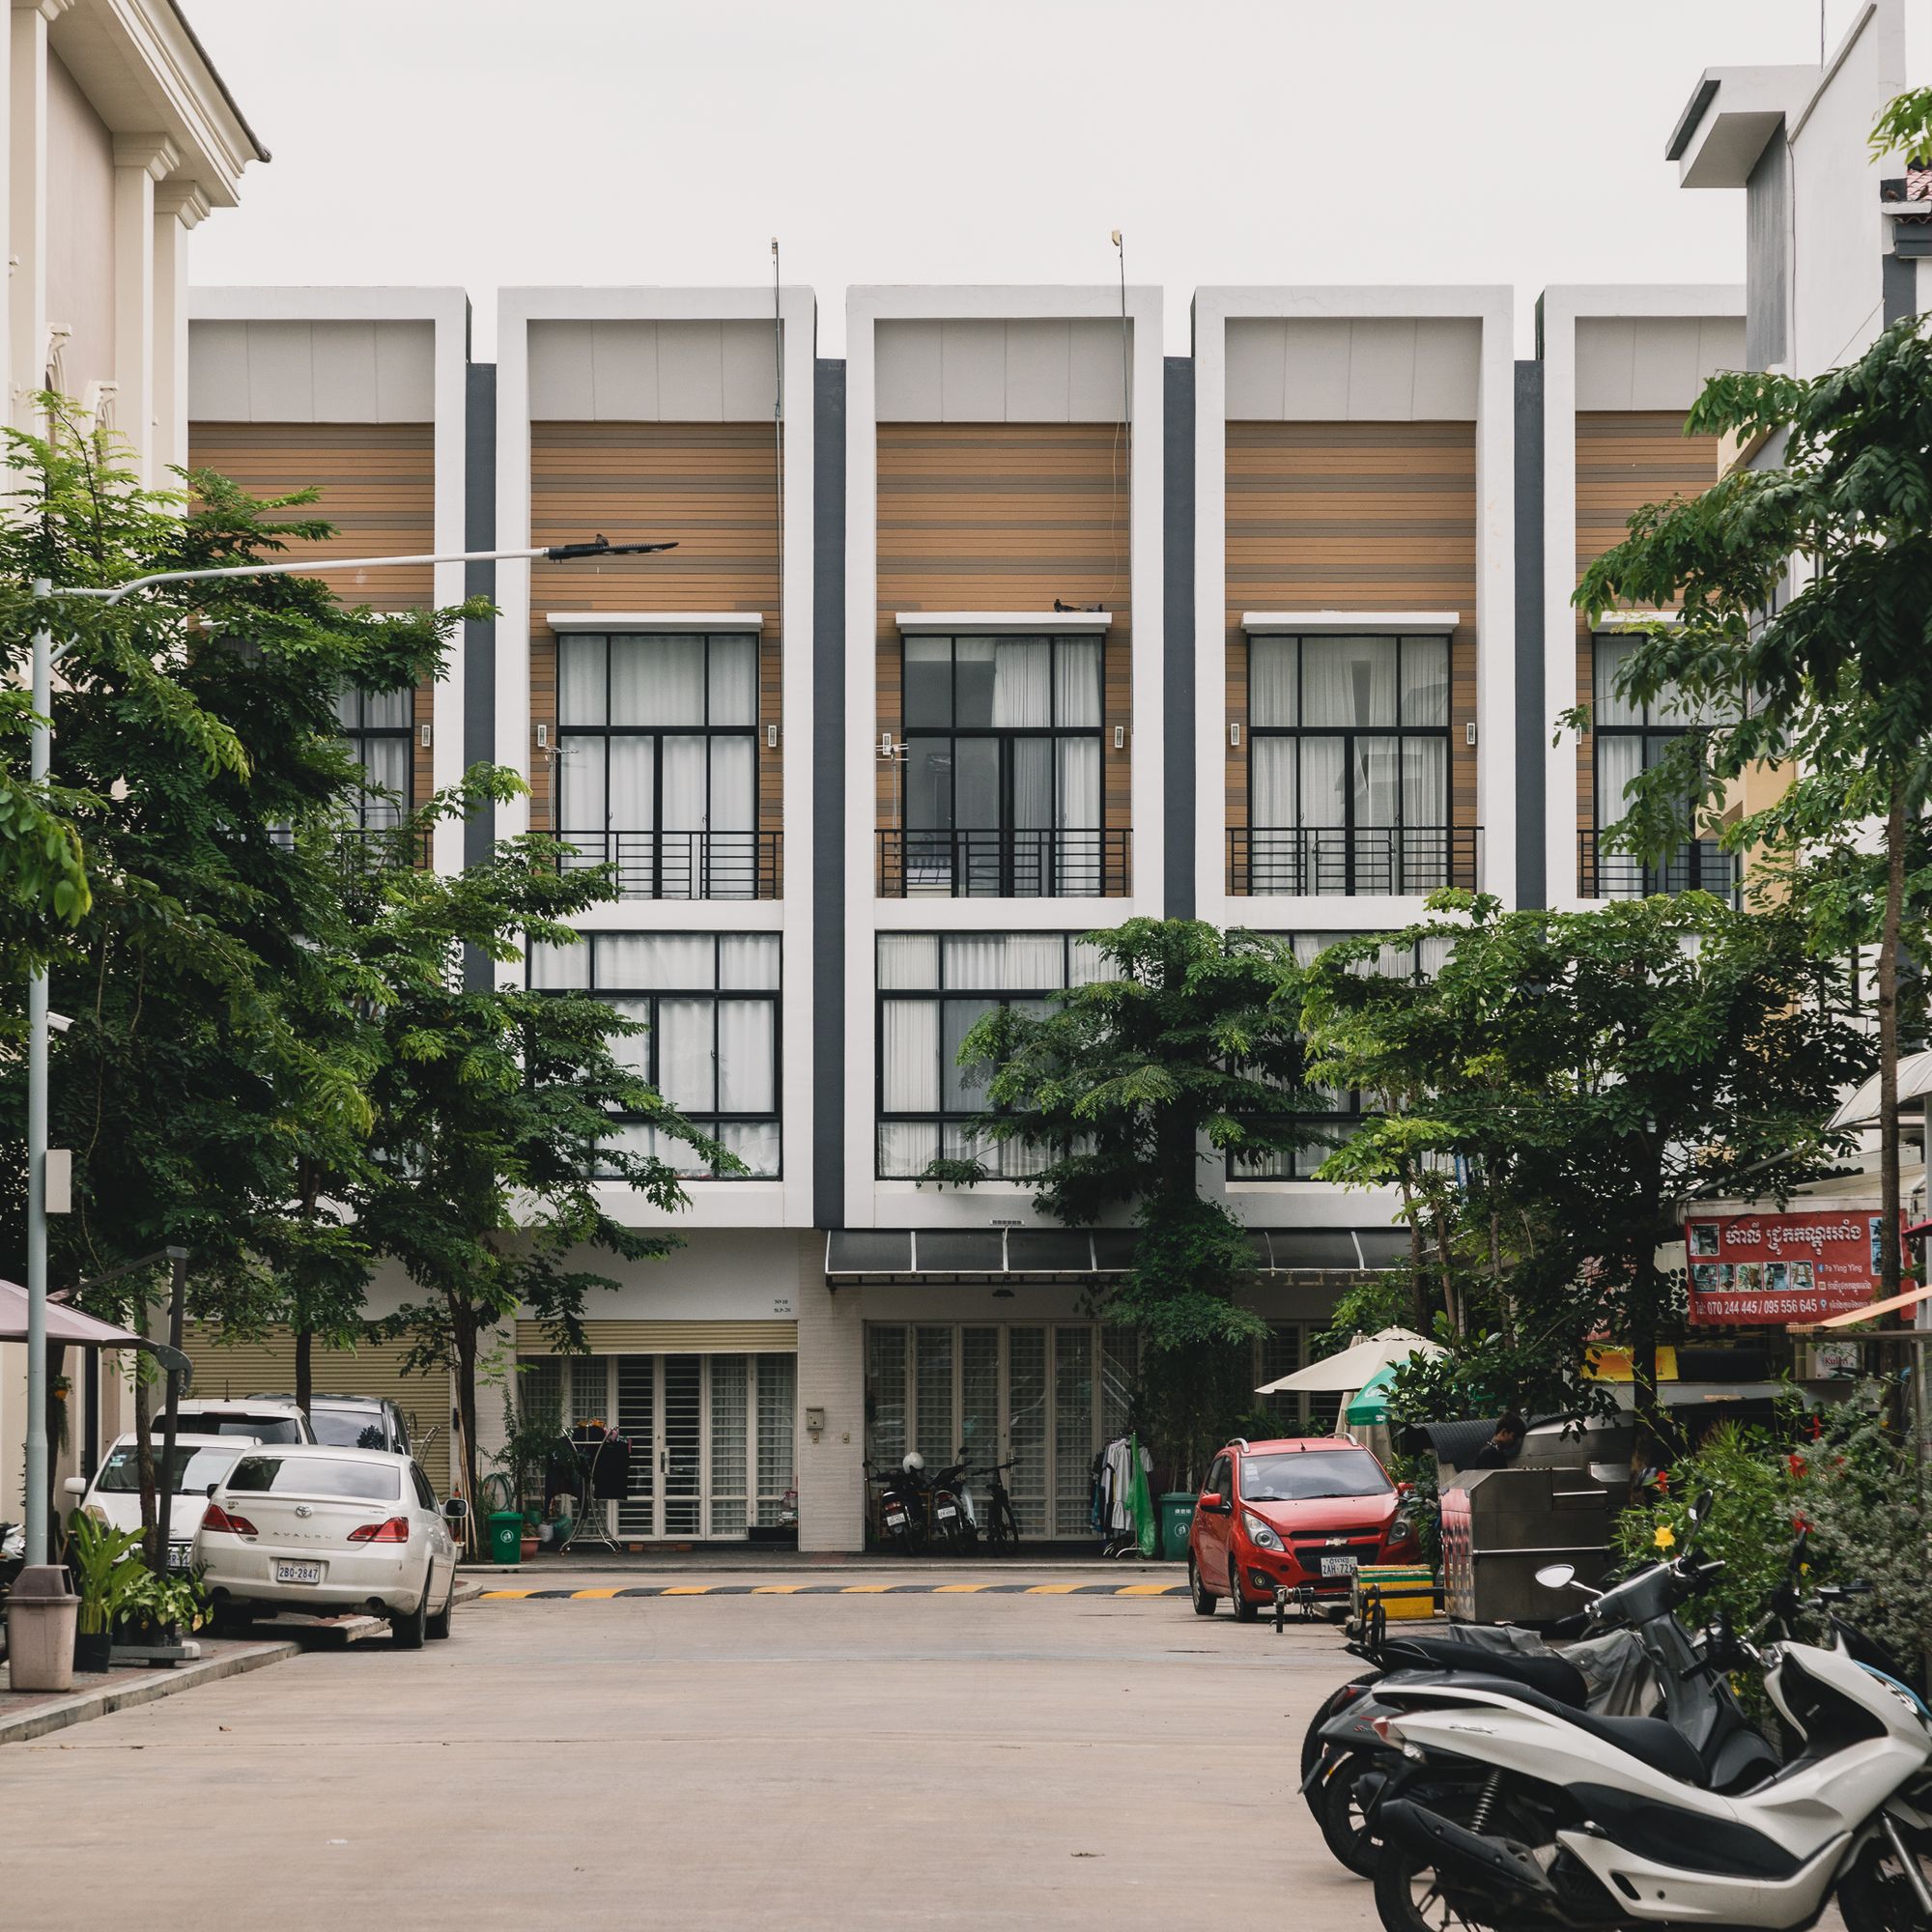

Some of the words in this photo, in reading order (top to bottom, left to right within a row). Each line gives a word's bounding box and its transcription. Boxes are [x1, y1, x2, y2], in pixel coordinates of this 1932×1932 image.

[1833, 1264, 1847, 1274] Ying
[1847, 1264, 1862, 1273] Ying
[1707, 1301, 1722, 1315] 070
[1724, 1301, 1740, 1315] 244
[1741, 1300, 1757, 1314] 445
[1763, 1299, 1779, 1314] 095
[1780, 1299, 1798, 1313] 556
[1799, 1298, 1818, 1313] 645
